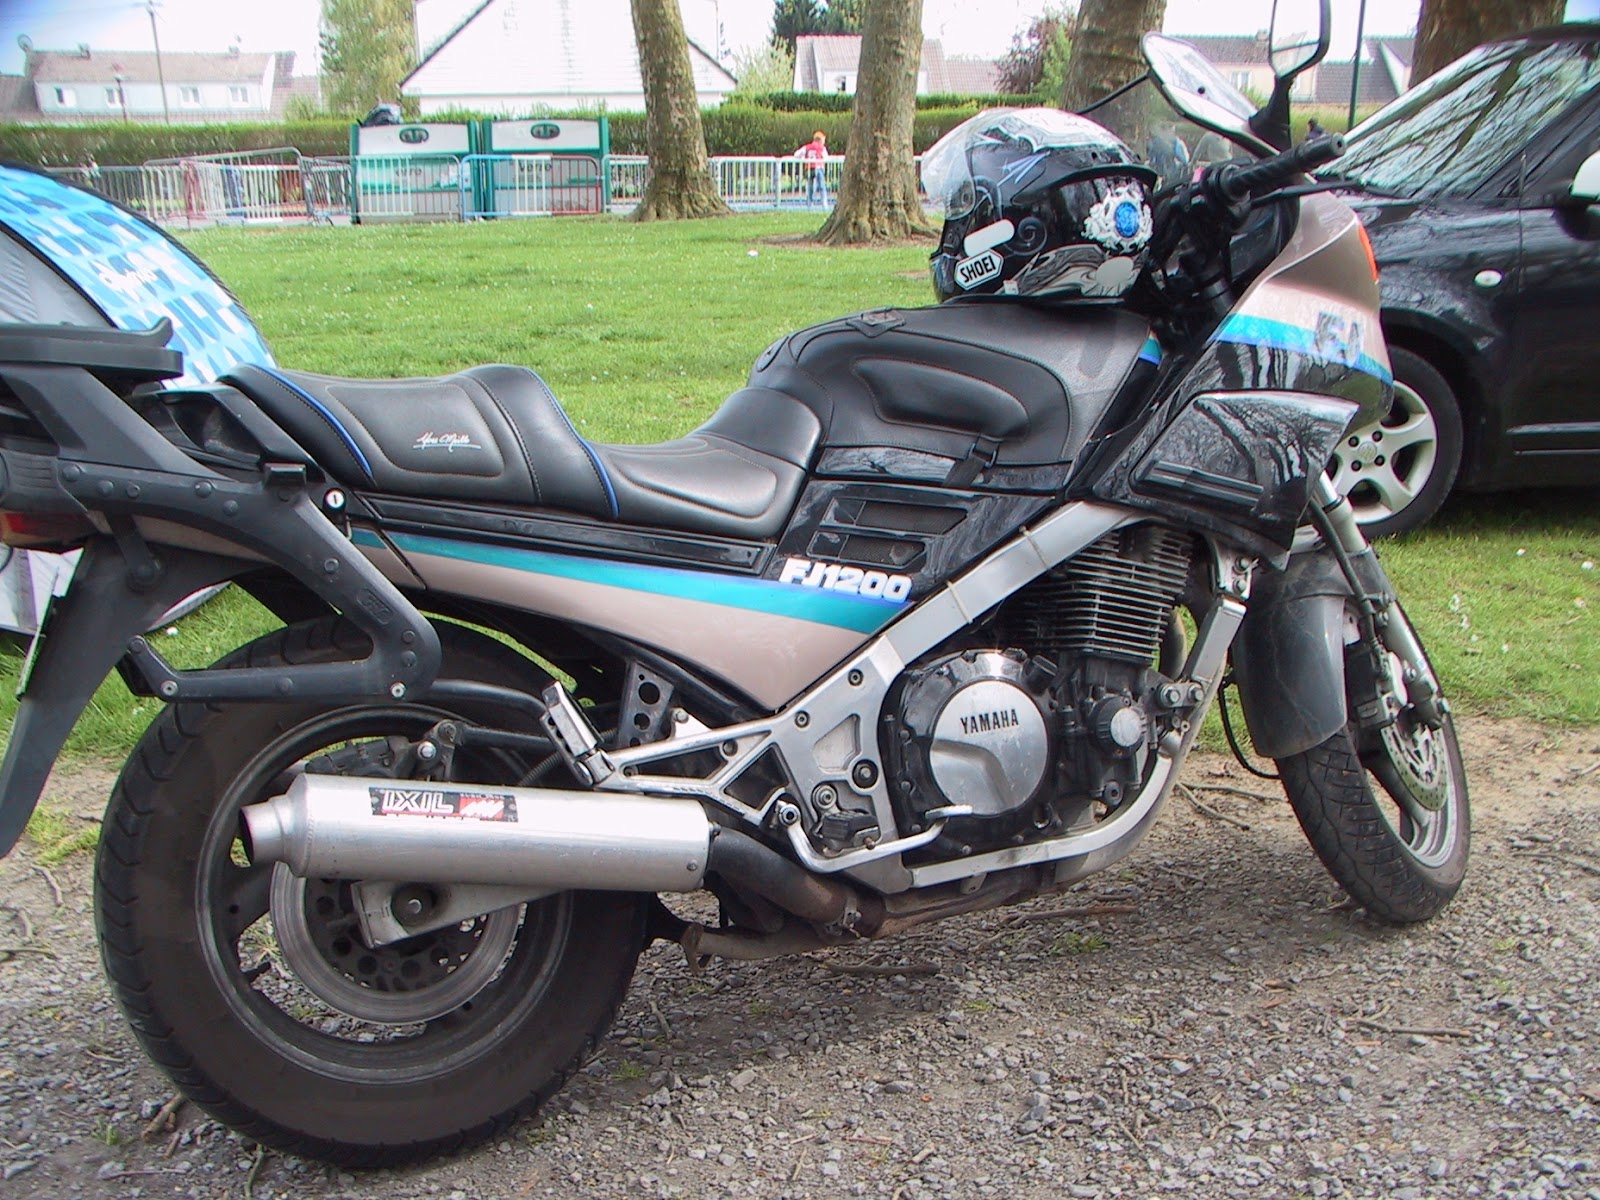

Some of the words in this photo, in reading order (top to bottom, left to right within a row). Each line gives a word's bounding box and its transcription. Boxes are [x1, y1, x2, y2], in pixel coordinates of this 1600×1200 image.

[960, 255, 996, 283] SHOEI
[779, 558, 912, 603] FJ1200
[960, 708, 1019, 734] YAMAHA
[381, 789, 453, 814] IXIL
